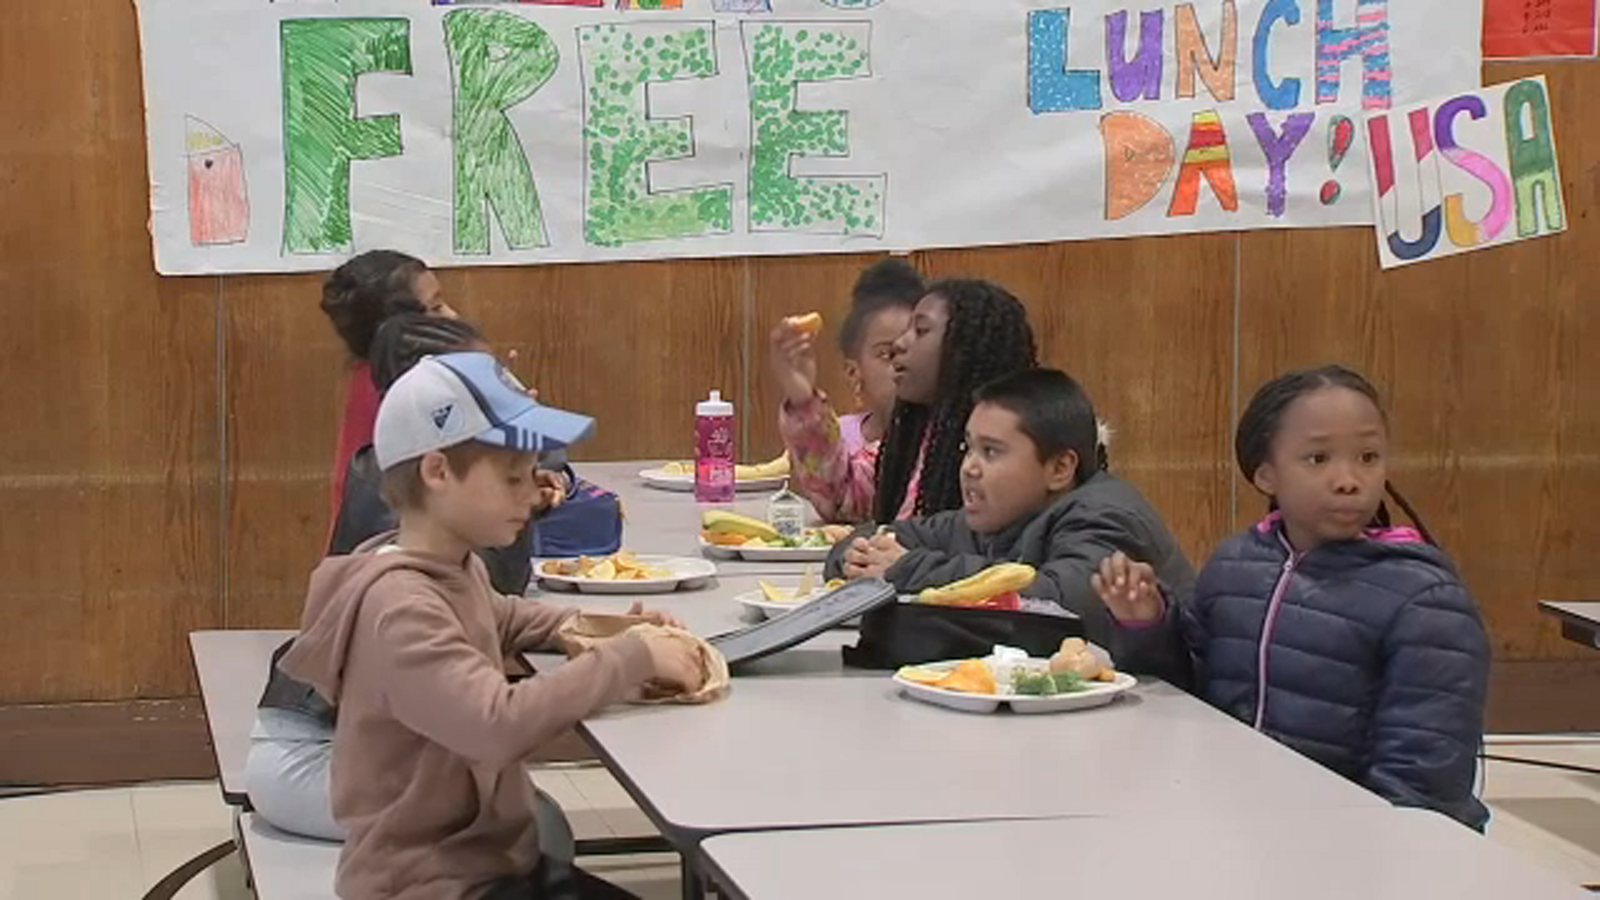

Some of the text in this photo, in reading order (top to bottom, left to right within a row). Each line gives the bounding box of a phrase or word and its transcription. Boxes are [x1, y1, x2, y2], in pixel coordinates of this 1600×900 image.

[1027, 0, 1392, 113] LUNCH
[280, 8, 887, 256] FREE
[1099, 109, 1356, 220] DAY!
[1366, 79, 1563, 260] USA
